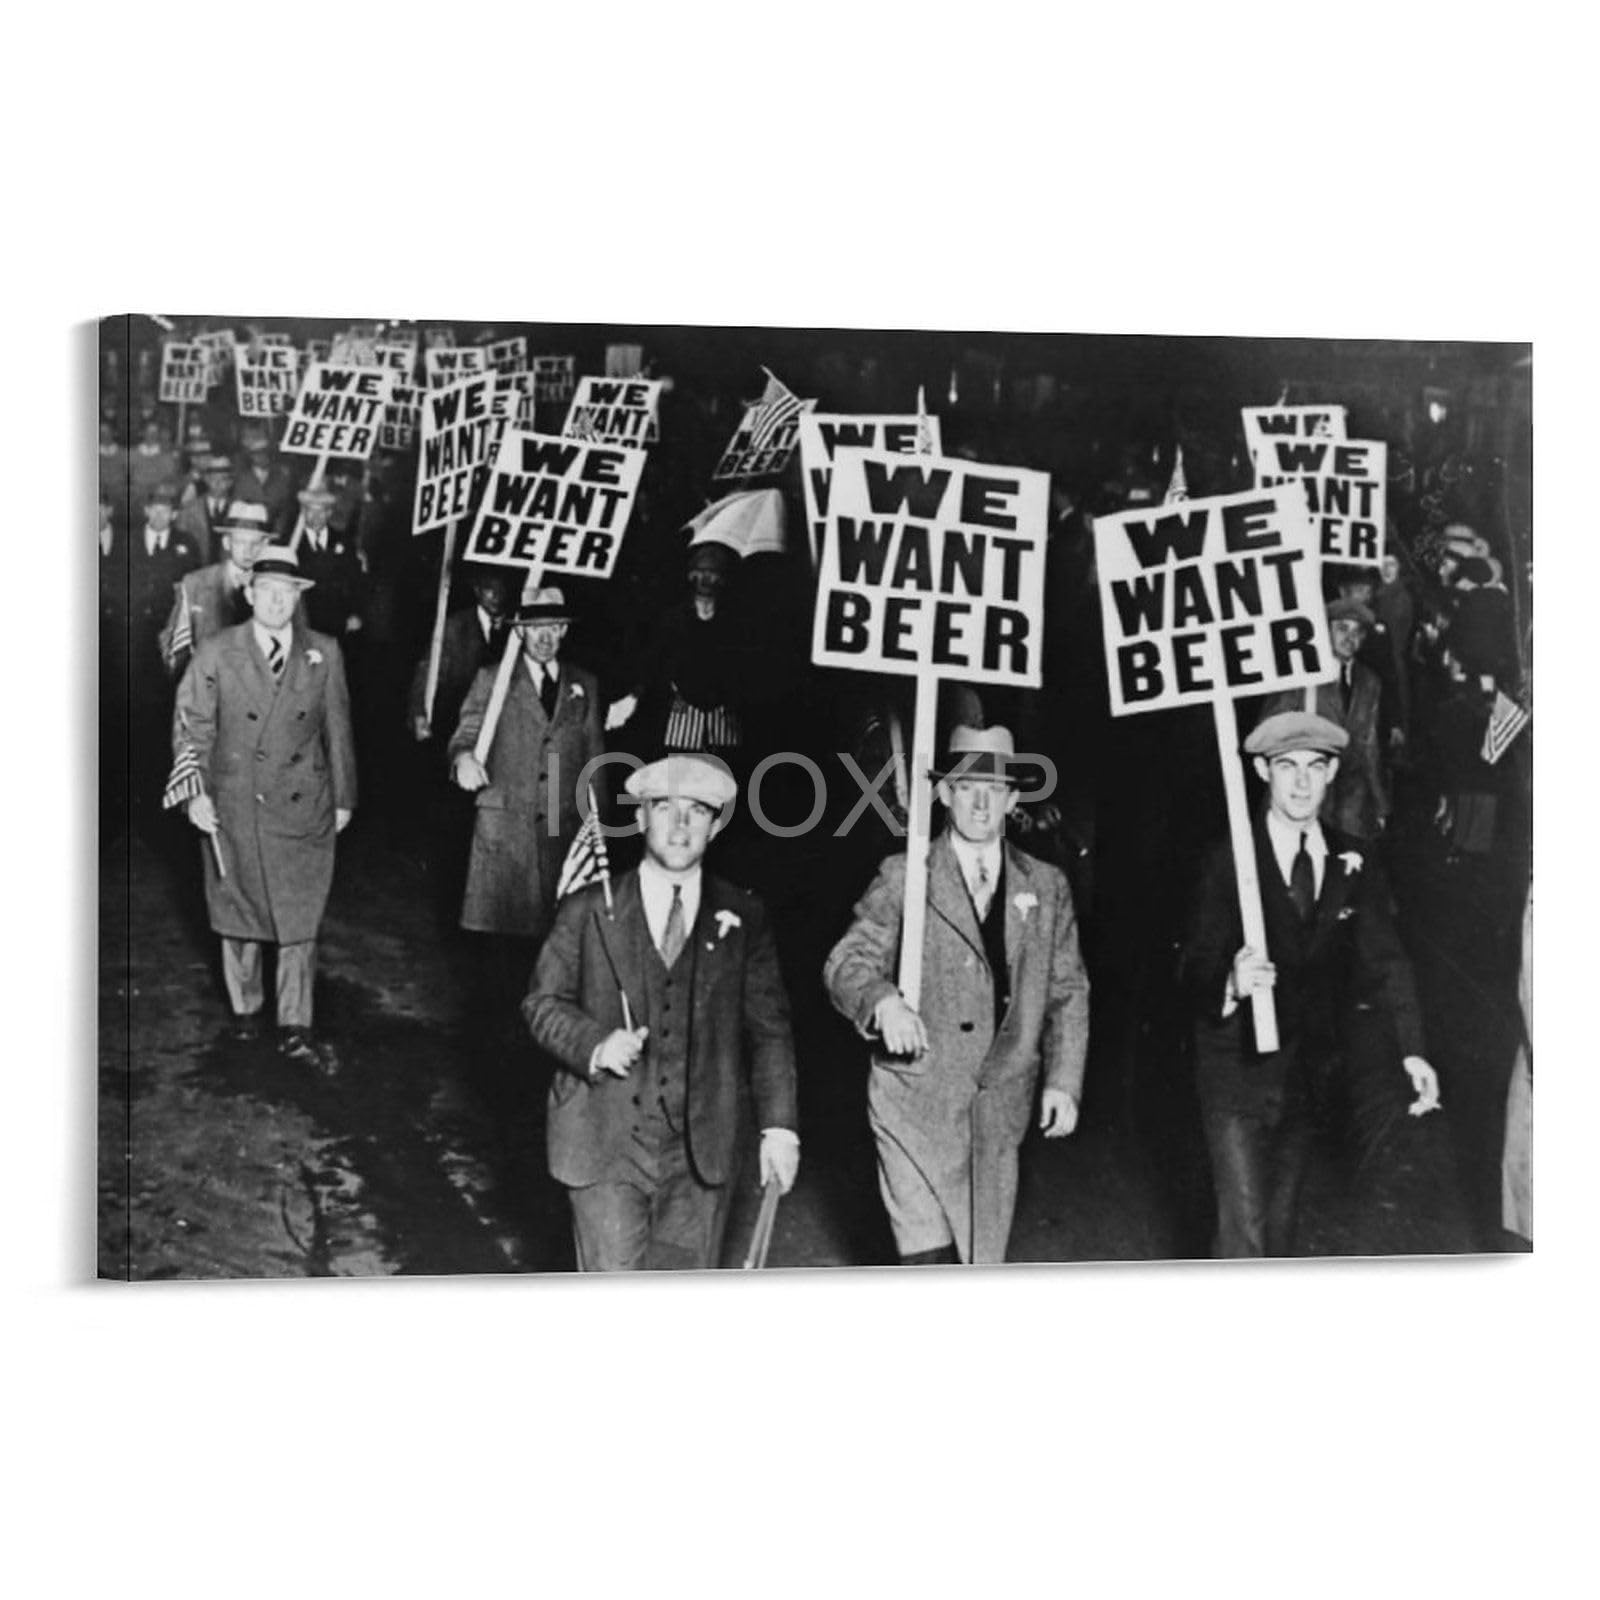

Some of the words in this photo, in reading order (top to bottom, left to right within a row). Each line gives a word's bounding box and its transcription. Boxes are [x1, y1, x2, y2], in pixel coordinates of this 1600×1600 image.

[241, 370, 293, 392] WANT
[320, 370, 382, 396] WE
[435, 352, 477, 369] WE
[302, 391, 383, 424] WANT
[433, 381, 485, 430] WE
[590, 383, 649, 406] WE
[289, 422, 371, 453] BEER
[426, 418, 490, 480] WANT
[522, 437, 626, 485] WE
[818, 423, 919, 462] WE
[1275, 442, 1369, 477] WE
[492, 472, 629, 529] WANT
[863, 459, 1020, 530] WE
[473, 514, 614, 571] BEER
[837, 515, 1034, 601] WANT
[1122, 499, 1282, 570] WE
[1309, 516, 1377, 559] ER
[1110, 549, 1304, 637] WANT
[824, 589, 1030, 675] BEER
[1117, 616, 1321, 705] BEER
